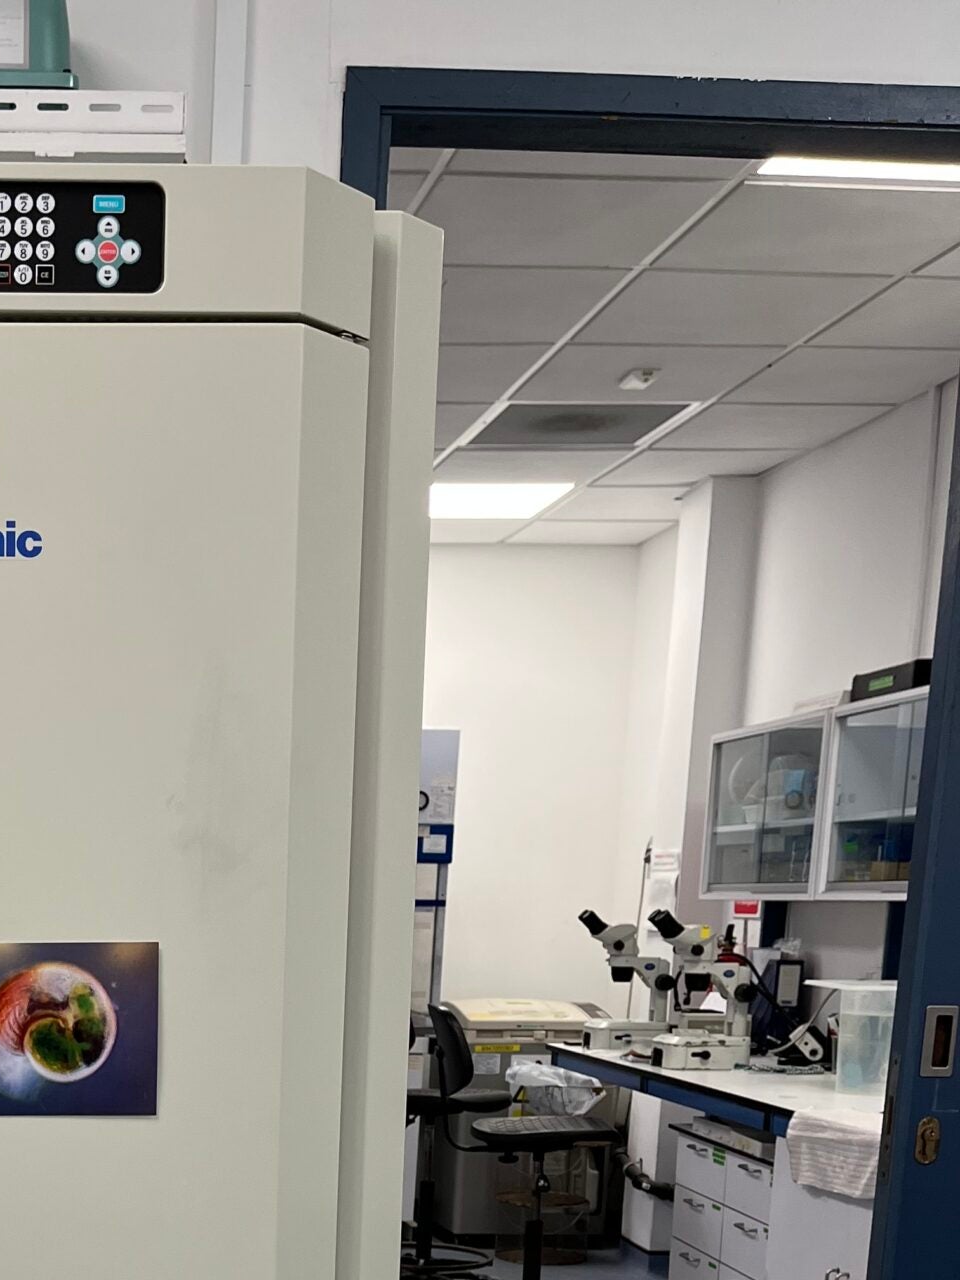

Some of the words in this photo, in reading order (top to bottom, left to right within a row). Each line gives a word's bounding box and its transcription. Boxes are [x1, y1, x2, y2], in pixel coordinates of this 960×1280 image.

[0, 200, 4, 211] 1
[20, 201, 28, 211] 2
[42, 201, 49, 211] 3
[20, 224, 27, 235] 5
[42, 224, 49, 235] 6
[0, 248, 5, 258] 7
[20, 248, 27, 259] 8
[42, 248, 49, 259] 9
[20, 272, 27, 283] 0
